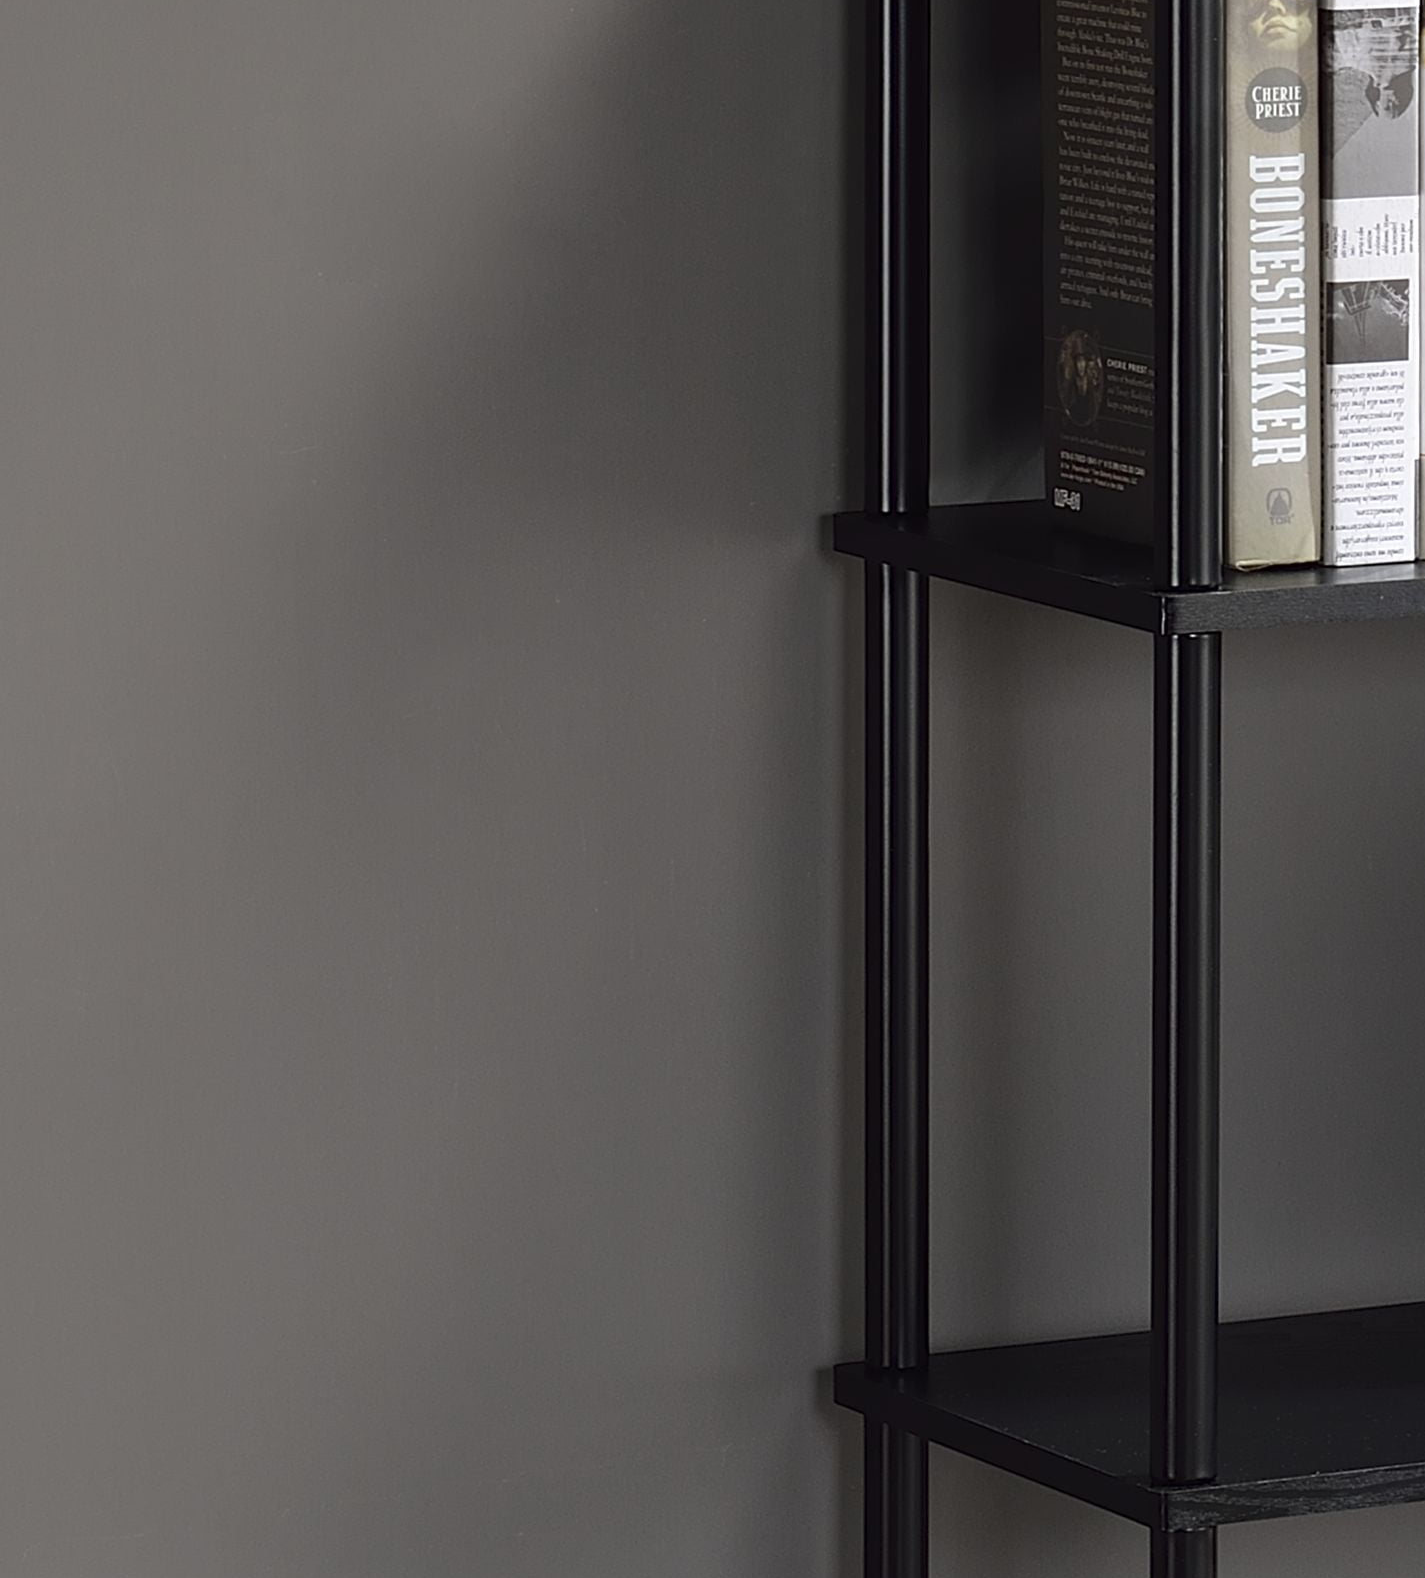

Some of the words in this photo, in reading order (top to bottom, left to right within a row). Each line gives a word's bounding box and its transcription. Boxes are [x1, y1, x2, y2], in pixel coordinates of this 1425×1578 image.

[1252, 85, 1302, 102] CHERIE
[1255, 102, 1302, 119] PRIEST
[1249, 153, 1306, 467] BONESHAKER
